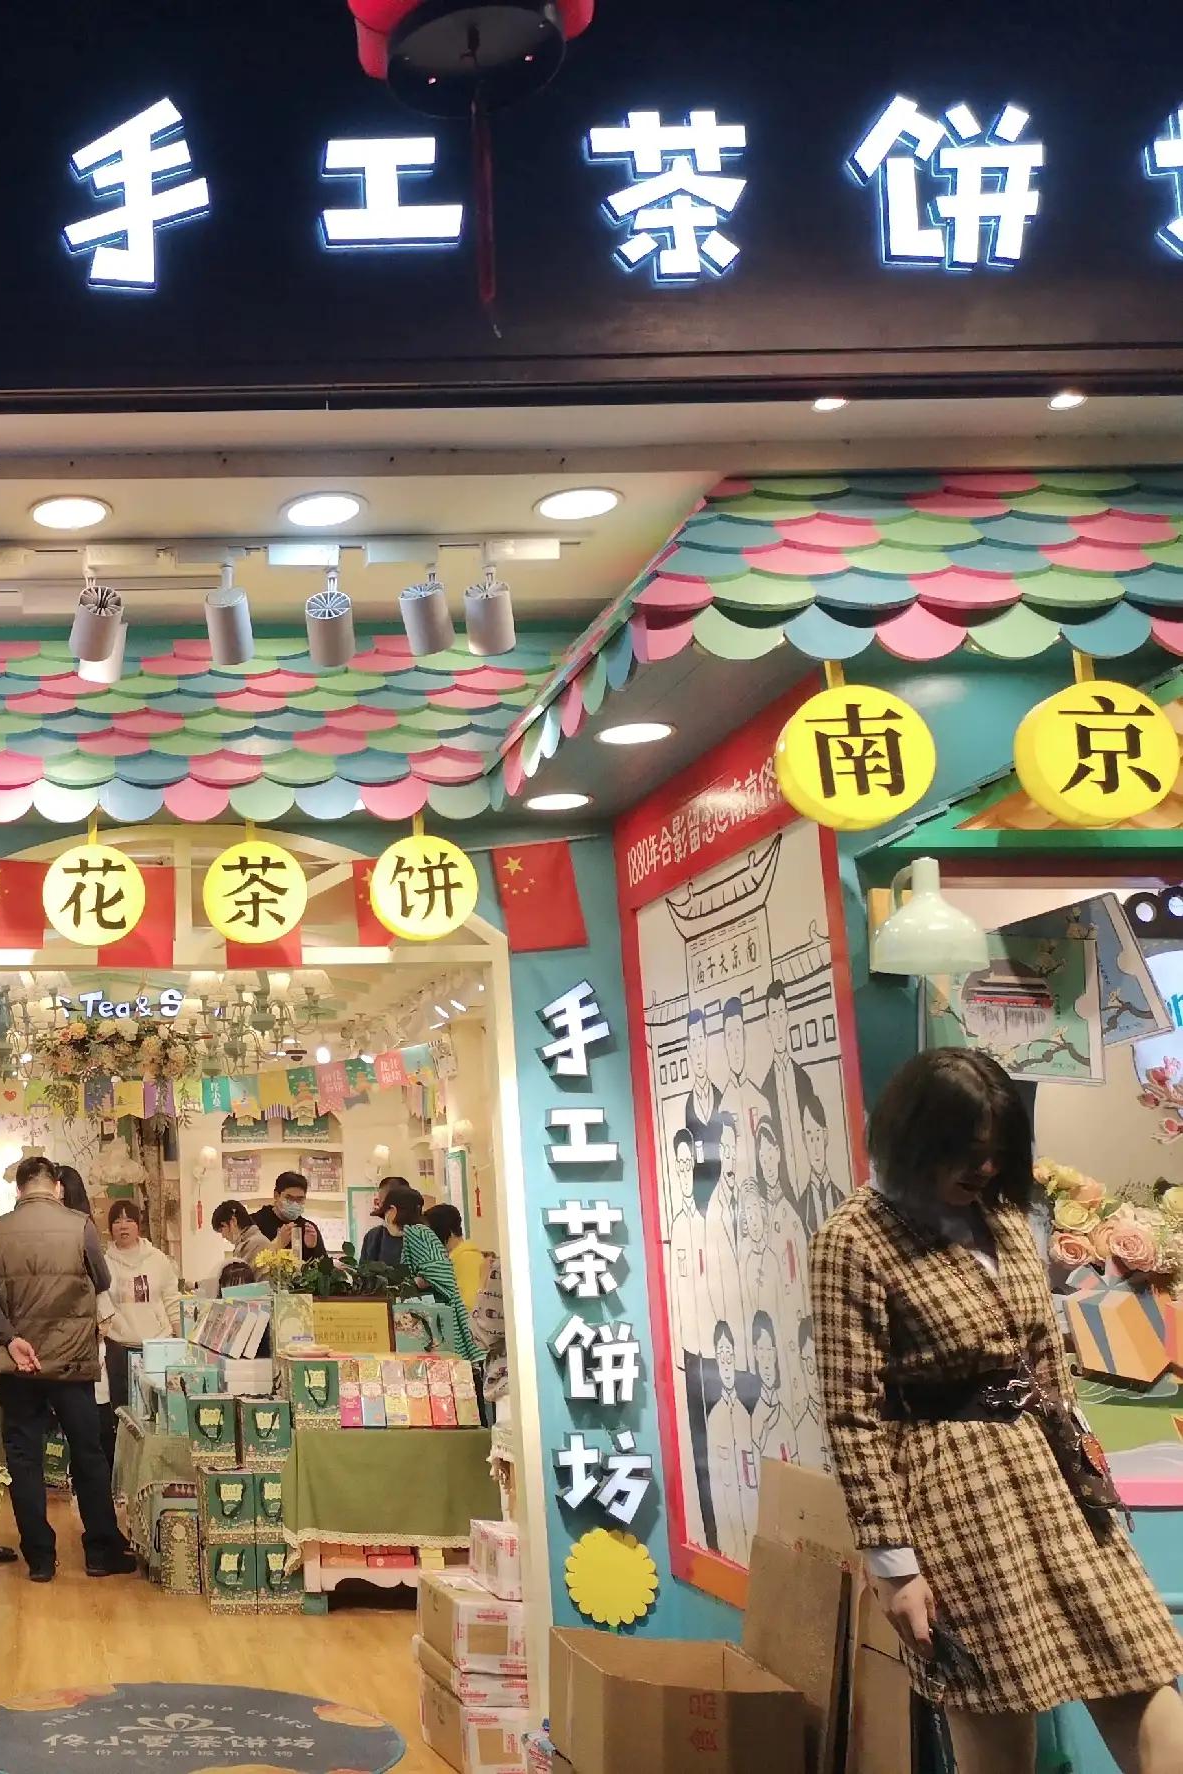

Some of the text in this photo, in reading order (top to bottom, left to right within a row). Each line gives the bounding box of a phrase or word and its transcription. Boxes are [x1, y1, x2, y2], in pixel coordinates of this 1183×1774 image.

[63, 95, 1183, 291] 手工茶饼
[803, 695, 1163, 800] 南京
[79, 990, 131, 1018] Tea
[539, 978, 654, 1527] 手工茶饼坊
